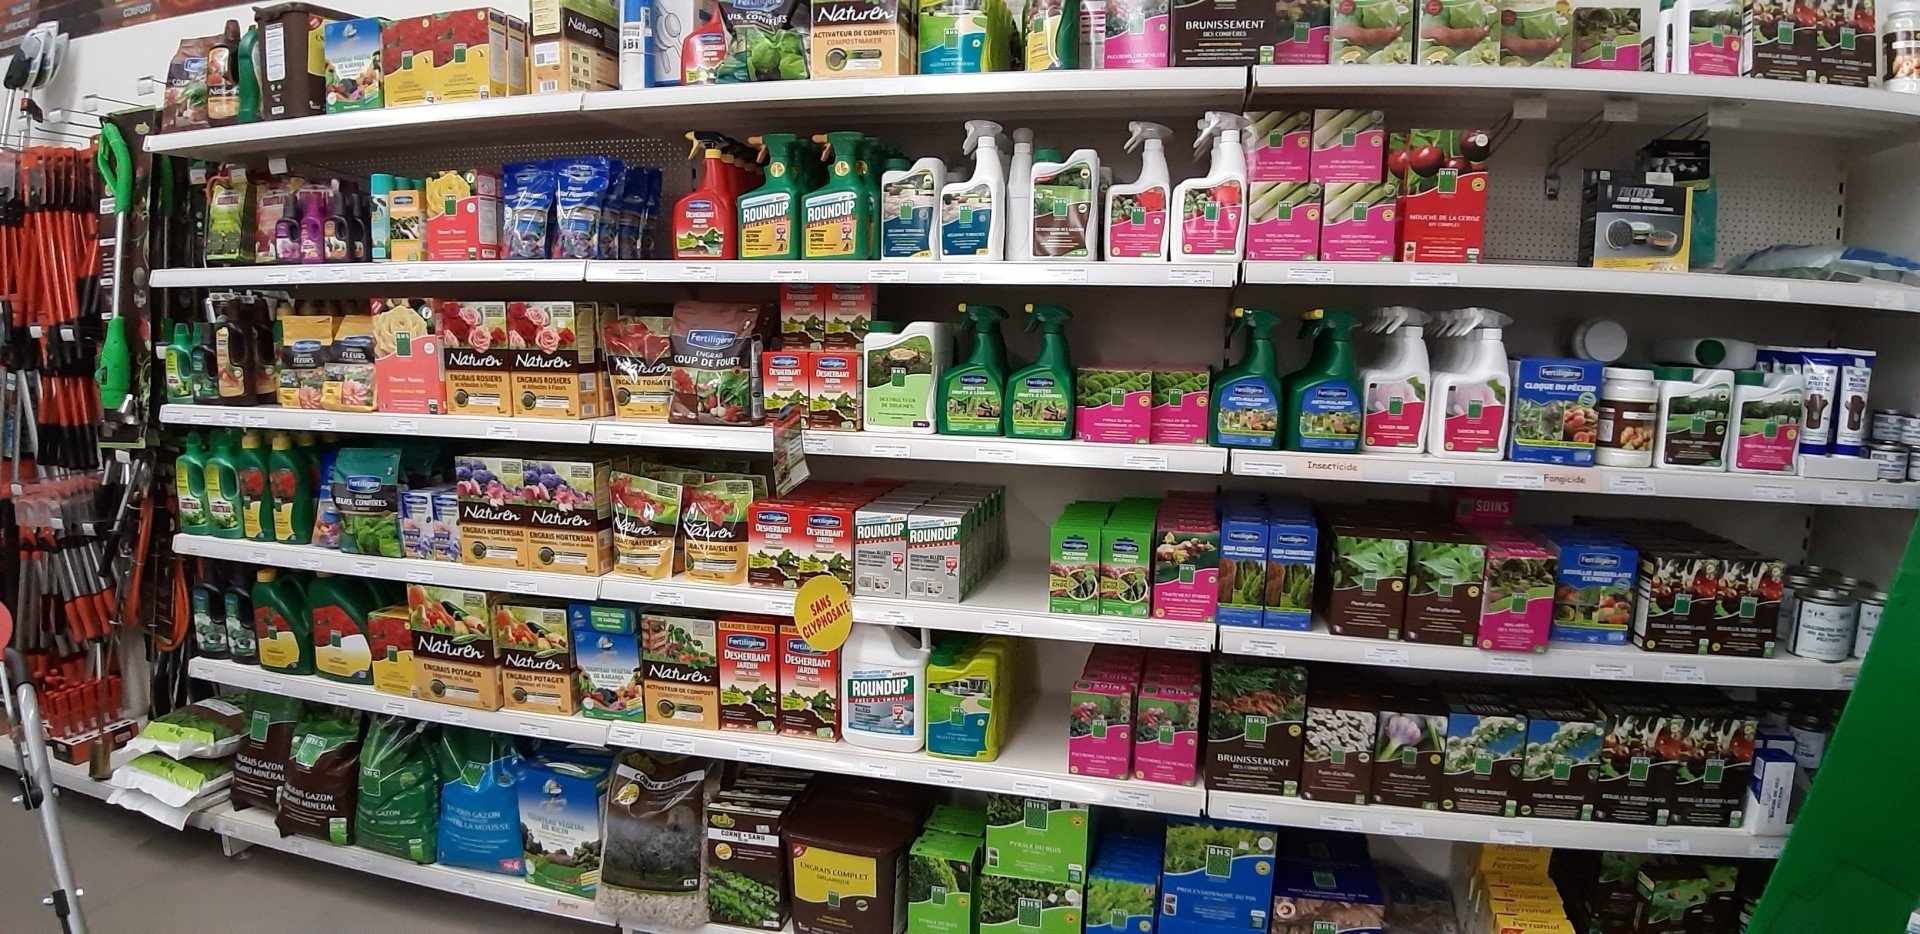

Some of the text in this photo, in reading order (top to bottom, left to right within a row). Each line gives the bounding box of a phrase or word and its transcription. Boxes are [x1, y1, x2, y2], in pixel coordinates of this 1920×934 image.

[817, 5, 894, 23] Naturen
[567, 16, 603, 39] Naturen
[1184, 19, 1265, 31] BRUNISSEMENT
[813, 30, 851, 39] ACTIVATEUR
[864, 29, 896, 37] COMPOST
[826, 37, 883, 46] COMPOSTMAKER
[1618, 186, 1655, 199] FILTRES
[743, 202, 789, 223] ROUNDUP
[807, 200, 855, 223] ROUNDUP
[1409, 214, 1436, 222] MOUCHE
[690, 333, 734, 347] Fertiligène
[293, 357, 314, 365] FLEURS
[342, 351, 366, 360] FLEURS
[449, 353, 503, 367] Naturen
[515, 353, 573, 369] Naturen
[674, 355, 740, 367] COUP DE FOUET
[696, 351, 723, 359] ENGRAIS
[768, 368, 801, 376] DESHERBANT
[815, 369, 850, 378] DESHERBANT
[1541, 368, 1582, 379] Fertiligène
[450, 374, 503, 383] ENGRAIS ROSIERS
[516, 376, 572, 385] ENGRAIS ROSIERS
[1525, 383, 1552, 391] CLOQUE
[1555, 383, 1568, 391] DU
[1308, 460, 1358, 472] Insecticide
[1543, 474, 1586, 485] Fongicide
[1475, 499, 1509, 514] SOINS
[464, 505, 521, 522] Naturen
[531, 510, 592, 527] Naturen
[463, 526, 524, 537] ENGRAIS HORTENSIAS
[755, 524, 792, 534] DESHERBANT
[806, 528, 844, 538] DESHERBANT
[857, 523, 905, 539] ROUNDUP
[909, 527, 959, 543] ROUNDUP
[529, 532, 594, 543] ENGRAIS HORTENSIAS
[1581, 555, 1618, 566] Fertiligène
[810, 594, 832, 617] SANS
[802, 600, 851, 640] GLYPHOSATE
[418, 635, 485, 660] Naturen
[728, 635, 766, 649] Fertiligène
[505, 653, 563, 671] Naturen
[723, 650, 771, 663] DESHERBANT
[784, 654, 831, 669] DESHERBANT
[424, 663, 482, 679] ENGRAIS POTAGER
[649, 664, 711, 683] Naturen
[506, 672, 565, 684] ENGRAIS POTAGER
[646, 684, 678, 694] ACTIVATEUR
[852, 679, 909, 697] ROUNDUP
[1093, 682, 1126, 692] SOINS
[1160, 687, 1195, 697] SOINS
[306, 737, 325, 748] BHS
[257, 759, 284, 772] GAZON
[1216, 753, 1290, 767] BRUNISSEMENT
[252, 769, 286, 782] MINÉRAL
[633, 771, 659, 791] CORNE
[304, 791, 334, 802] GAZON
[301, 800, 338, 812] MINÉRAL
[1027, 801, 1047, 811] BHS
[375, 809, 401, 817] GAZON
[471, 810, 501, 819] GAZON
[541, 823, 570, 836] DE RICIN
[720, 829, 766, 842] CORNE SANG
[1009, 840, 1061, 854] PYRALE DU BUIS
[1209, 848, 1231, 857] BHS
[799, 861, 869, 881] ENGRAIS COMPLET
[1491, 860, 1539, 871] Ferramol
[816, 874, 850, 886] ORGANIQUE
[1503, 889, 1549, 900] Ferramol
[1021, 901, 1041, 909] BHS
[1505, 904, 1553, 914] Ferramol
[1511, 919, 1560, 931] Ferramol
